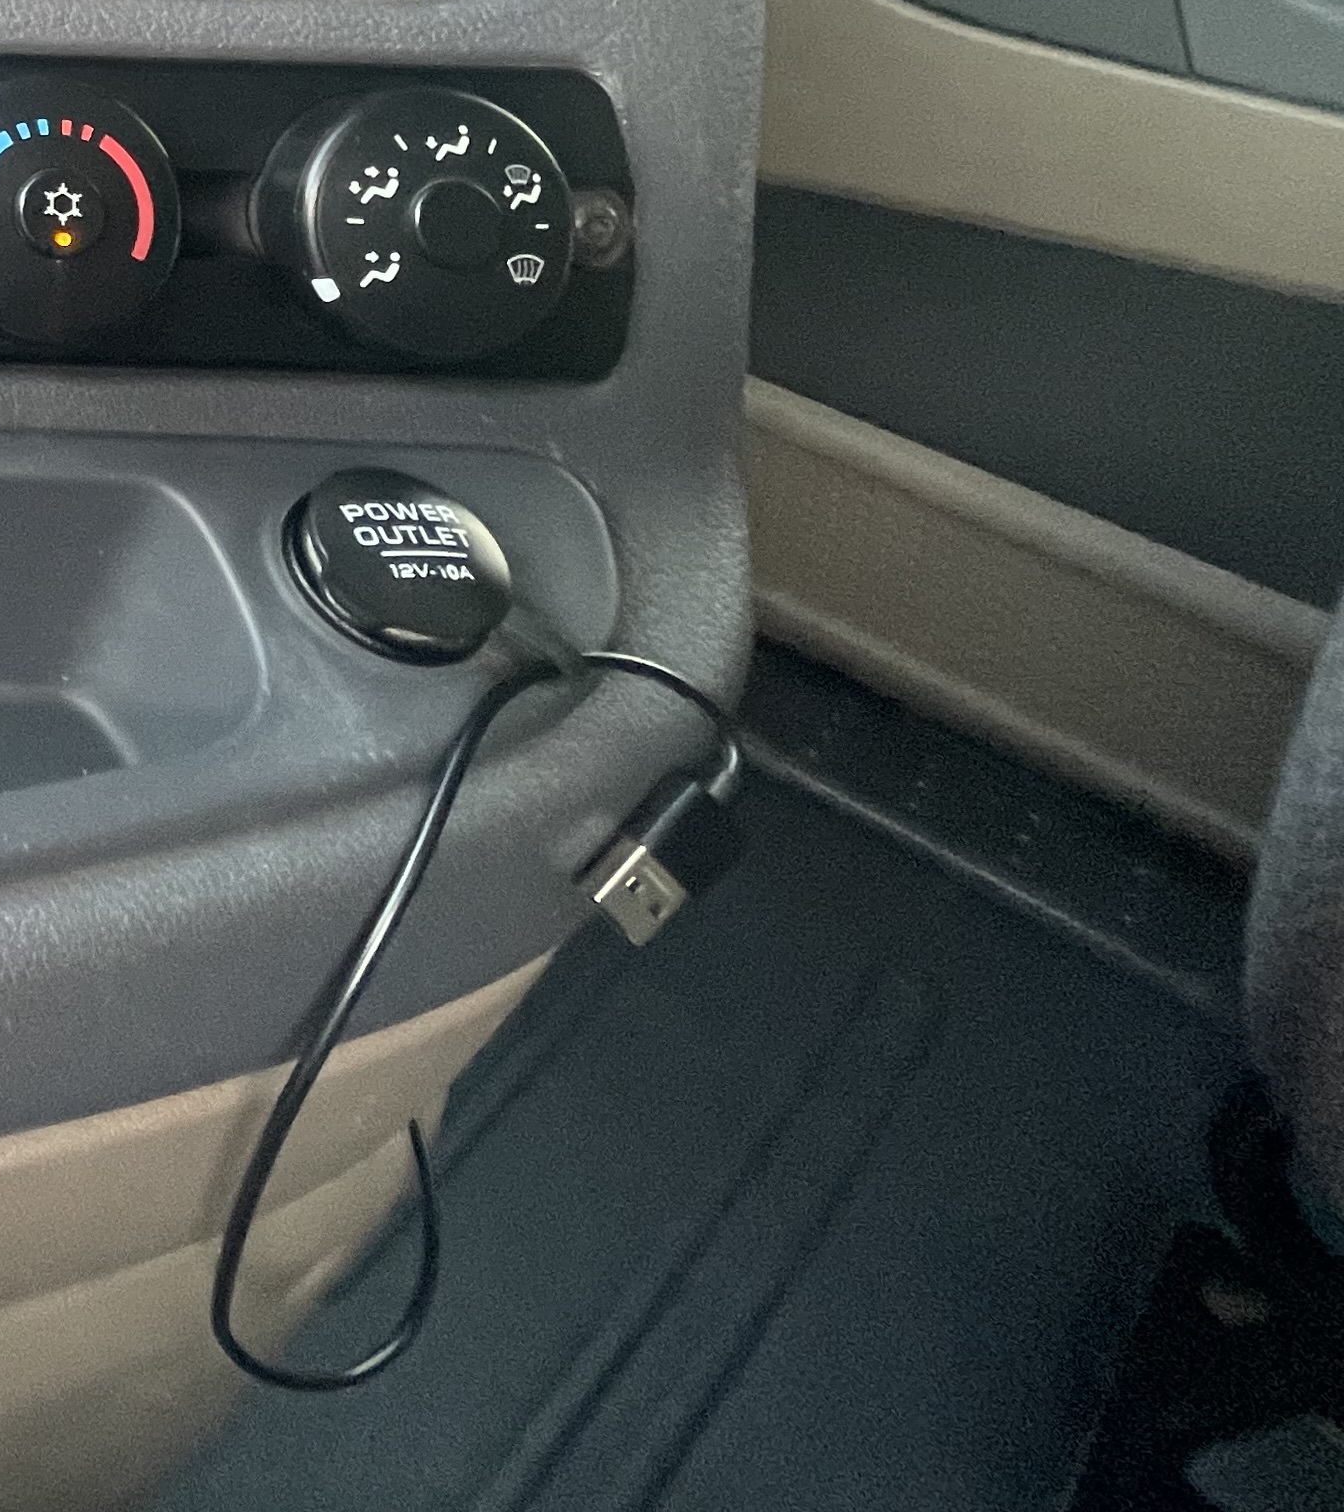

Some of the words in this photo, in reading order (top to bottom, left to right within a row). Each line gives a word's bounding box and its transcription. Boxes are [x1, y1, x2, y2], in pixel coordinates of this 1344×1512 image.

[339, 502, 460, 524] POWER
[353, 525, 469, 548] OUTLET
[389, 563, 475, 581] 12V-10A
